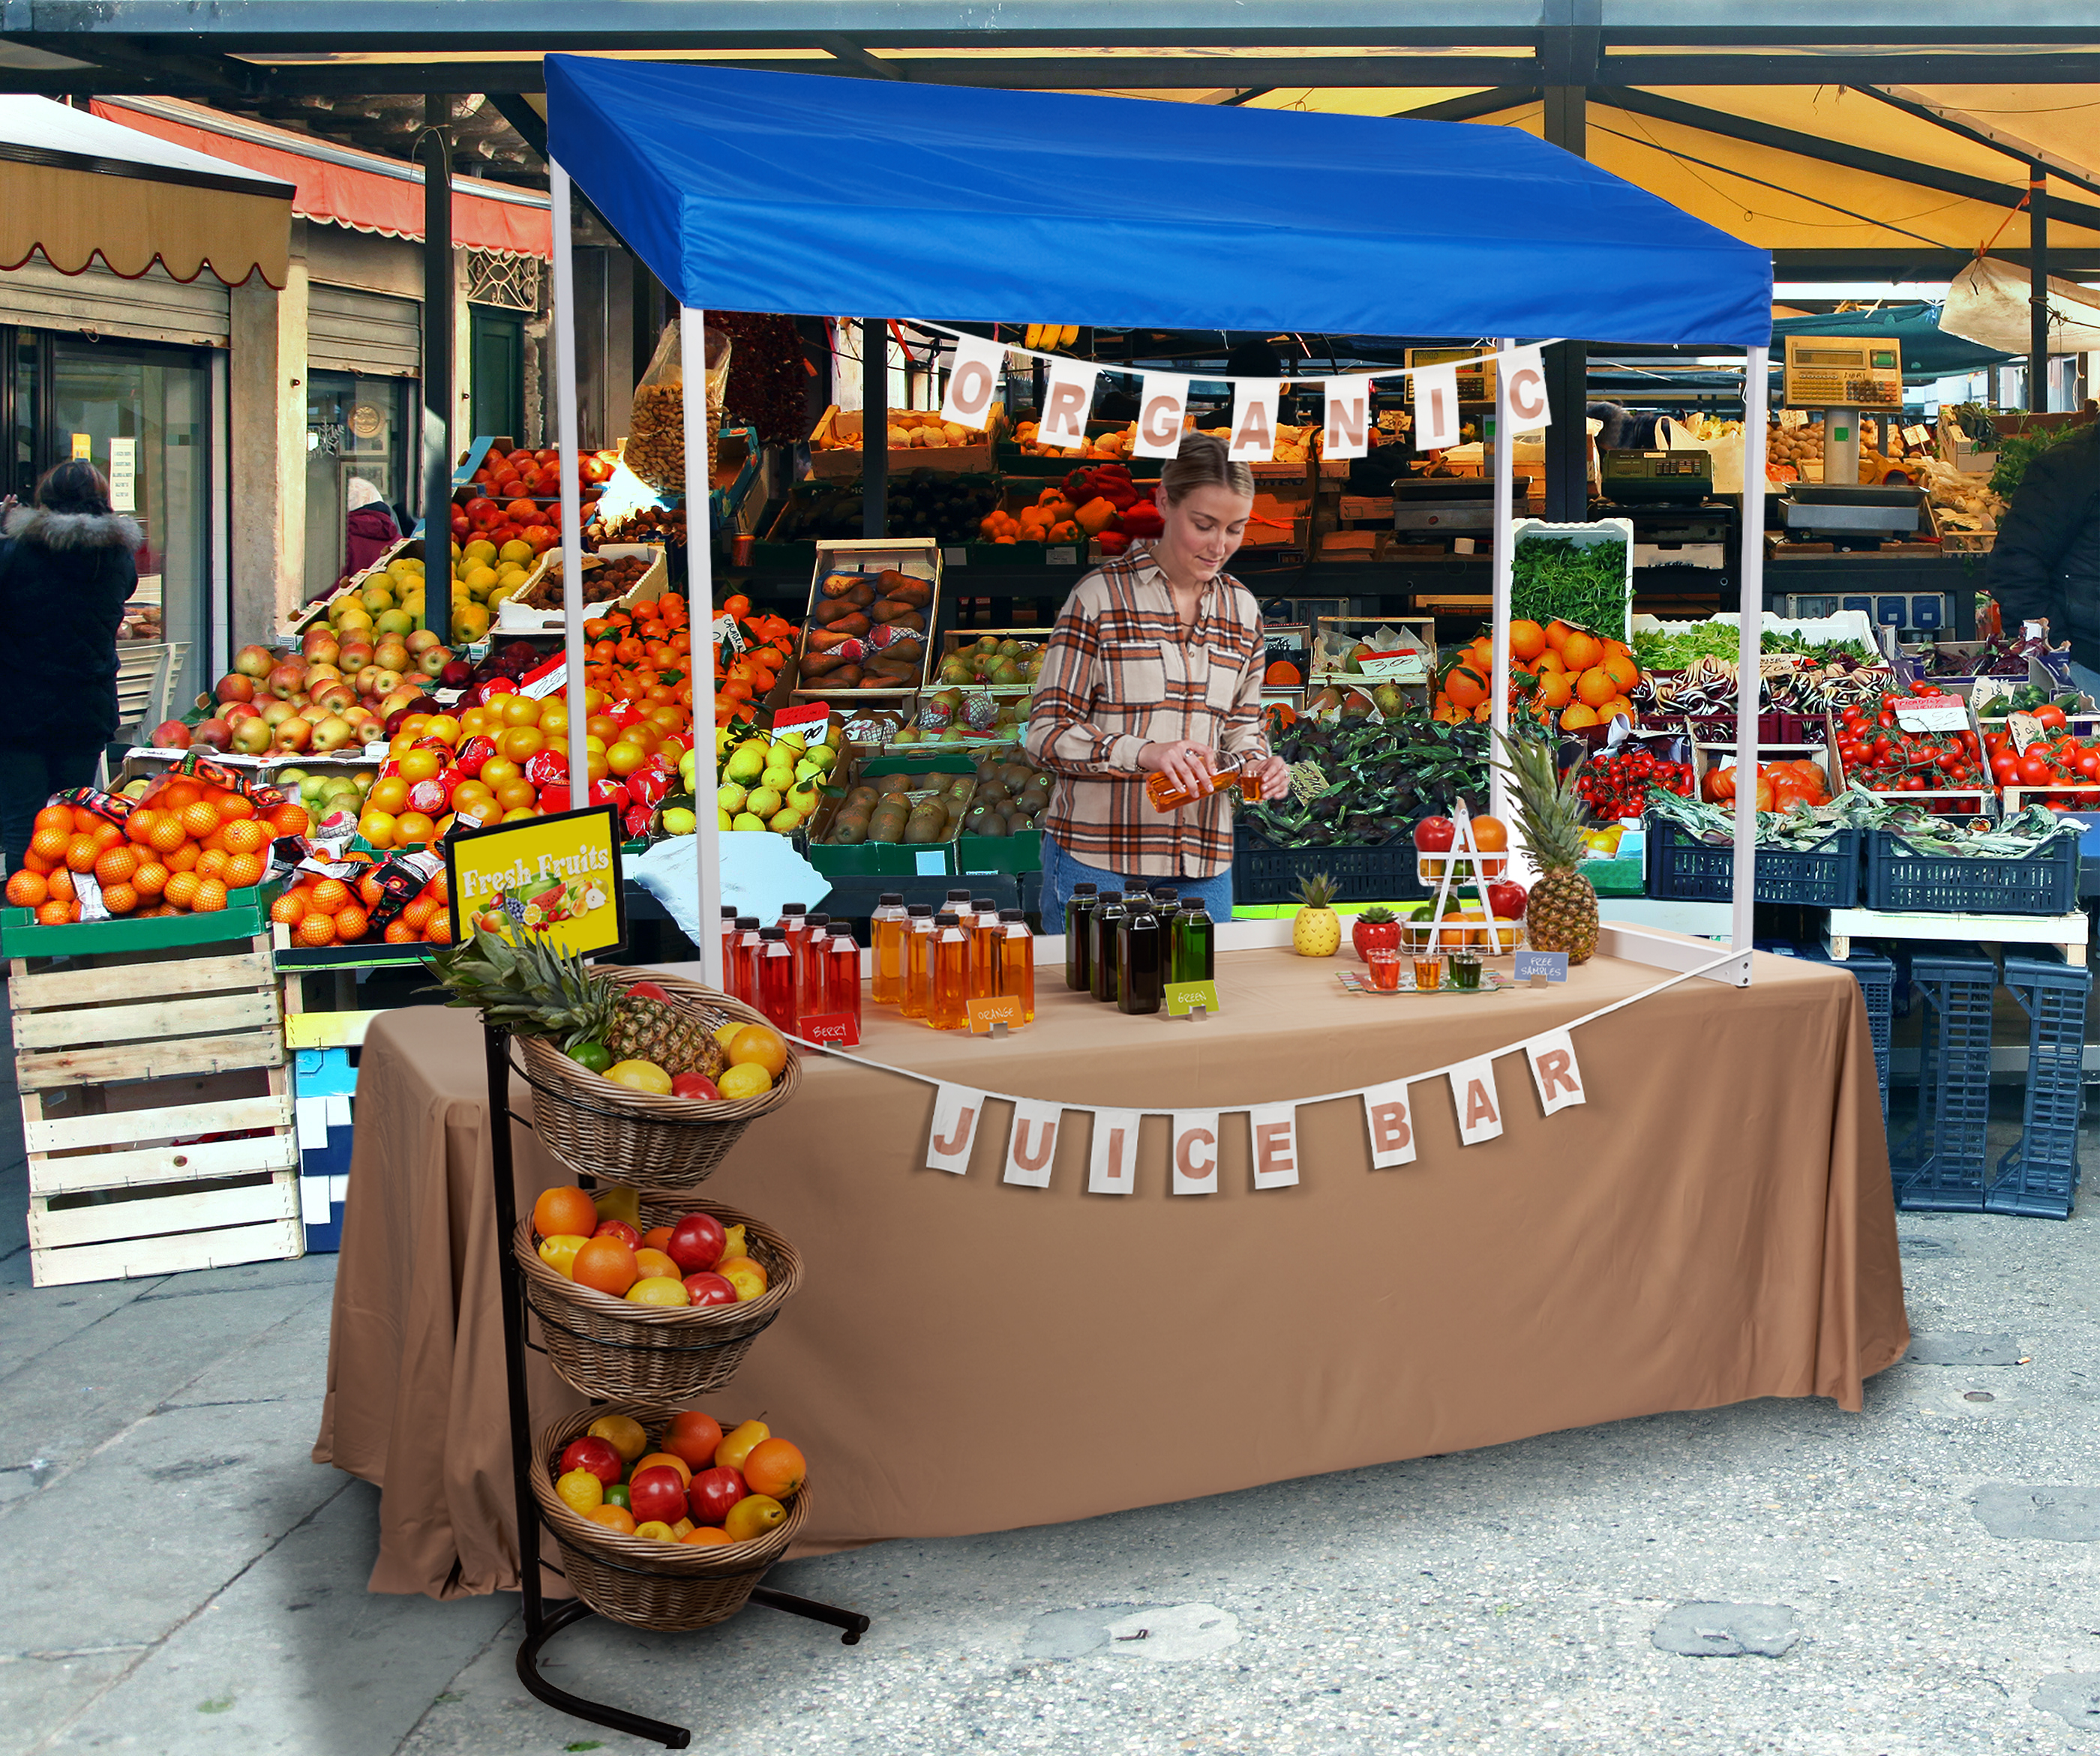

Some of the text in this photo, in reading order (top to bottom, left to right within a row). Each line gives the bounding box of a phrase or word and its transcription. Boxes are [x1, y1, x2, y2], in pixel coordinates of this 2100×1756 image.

[951, 360, 1545, 451] ORGANIC
[462, 858, 532, 898] Fresh
[536, 844, 610, 882] Fruits
[1531, 957, 1552, 966] FREE
[1520, 966, 1562, 976] SAMPLES
[1178, 990, 1207, 1003] GREEN
[977, 1007, 1014, 1020] ORANGE
[812, 1023, 847, 1038] BERRY
[933, 1048, 1580, 1180] JUICE BAR
